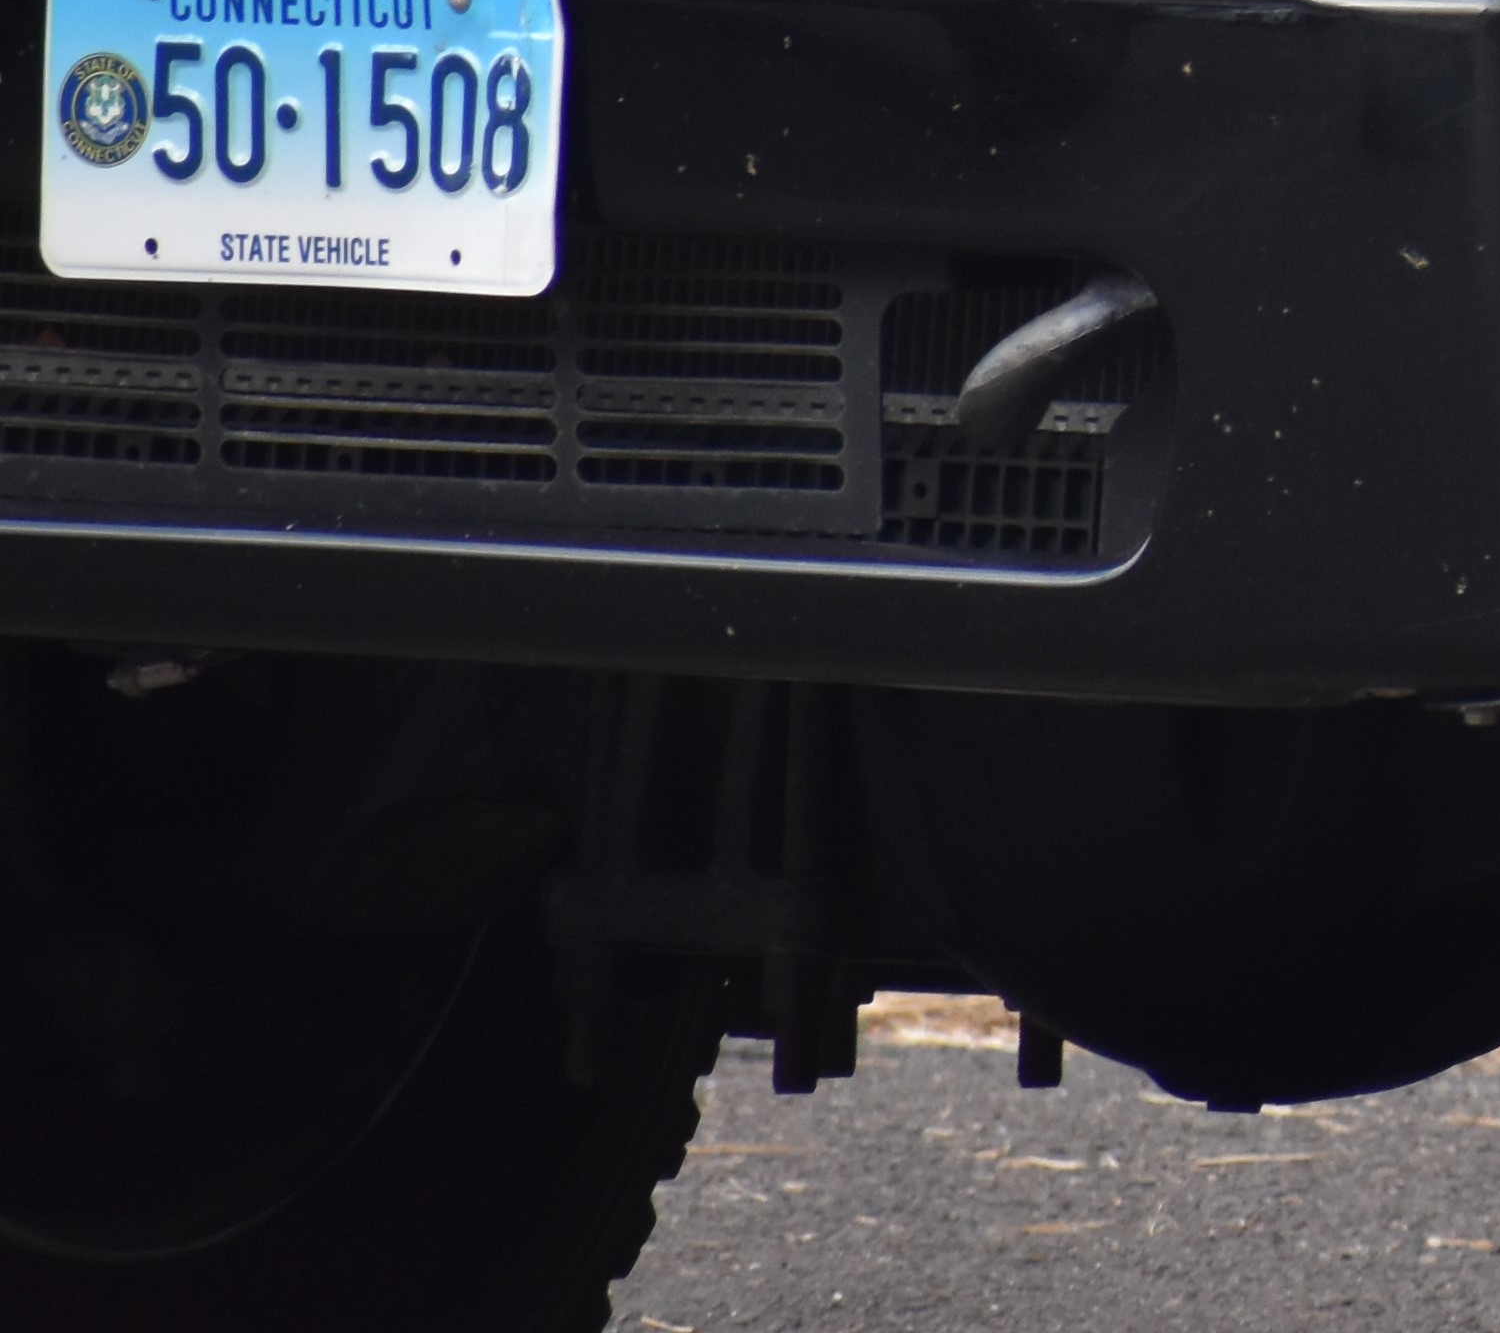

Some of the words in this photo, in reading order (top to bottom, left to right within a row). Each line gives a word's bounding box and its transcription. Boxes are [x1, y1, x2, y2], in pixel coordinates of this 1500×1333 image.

[75, 57, 113, 81] STATE
[119, 63, 138, 82] OF
[62, 120, 147, 163] CONNECTICUT
[220, 232, 290, 265] STATE
[298, 235, 391, 268] VEHICLE
